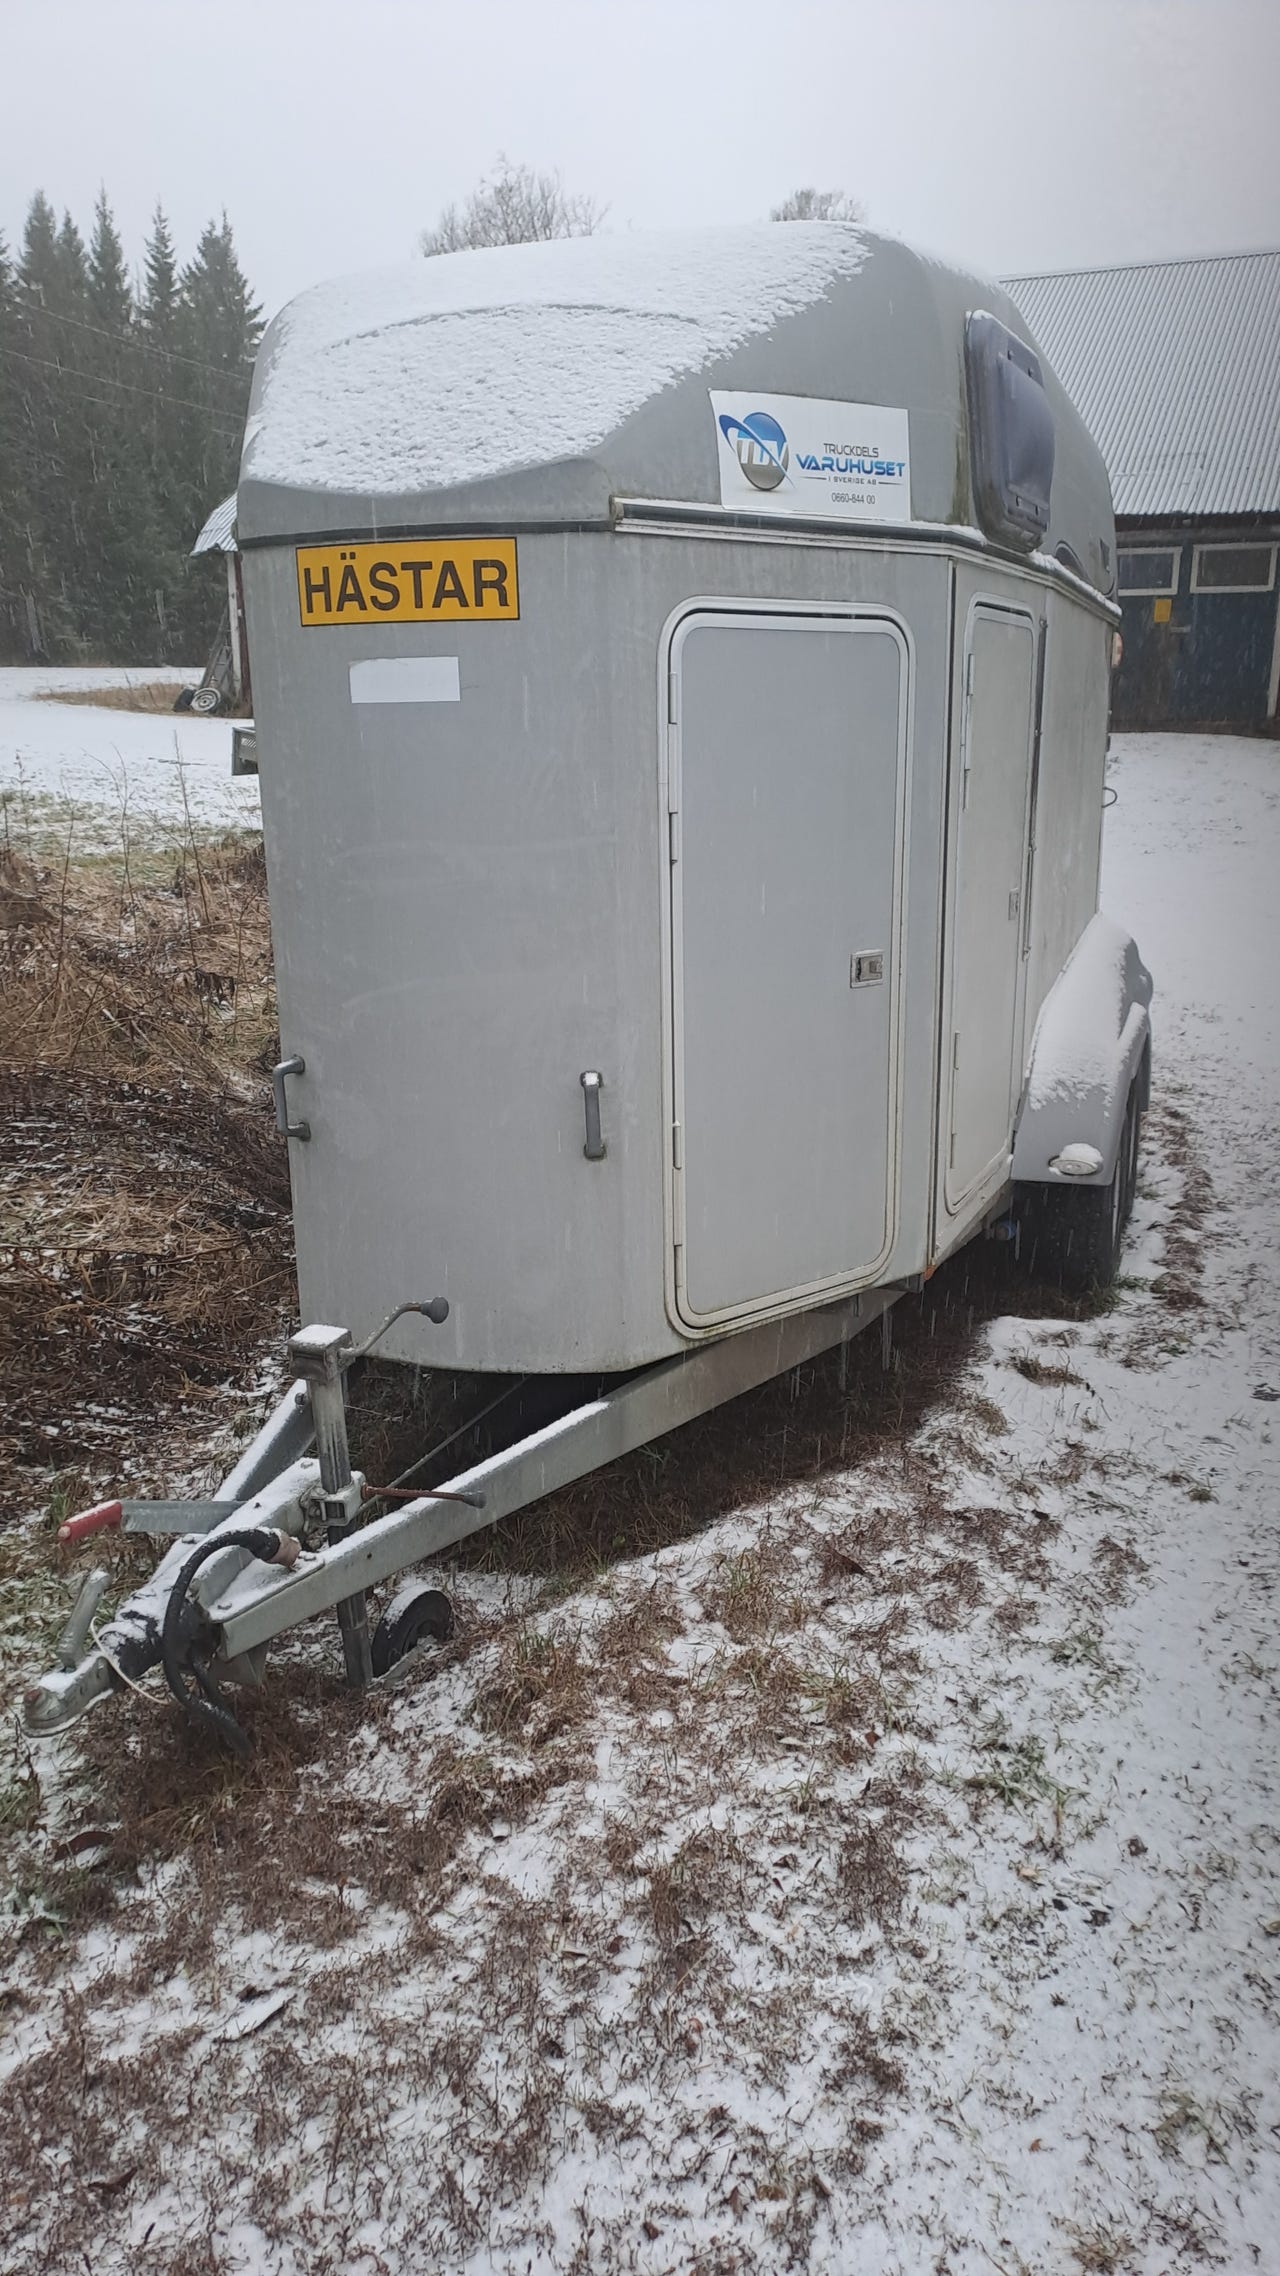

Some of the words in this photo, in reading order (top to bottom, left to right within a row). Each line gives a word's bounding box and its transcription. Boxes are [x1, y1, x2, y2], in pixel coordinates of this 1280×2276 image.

[823, 443, 879, 458] TRUCKDELS
[795, 453, 906, 477] VARUHUSET
[833, 476, 865, 485] SVERIGE
[303, 552, 510, 614] HÄSTAR
